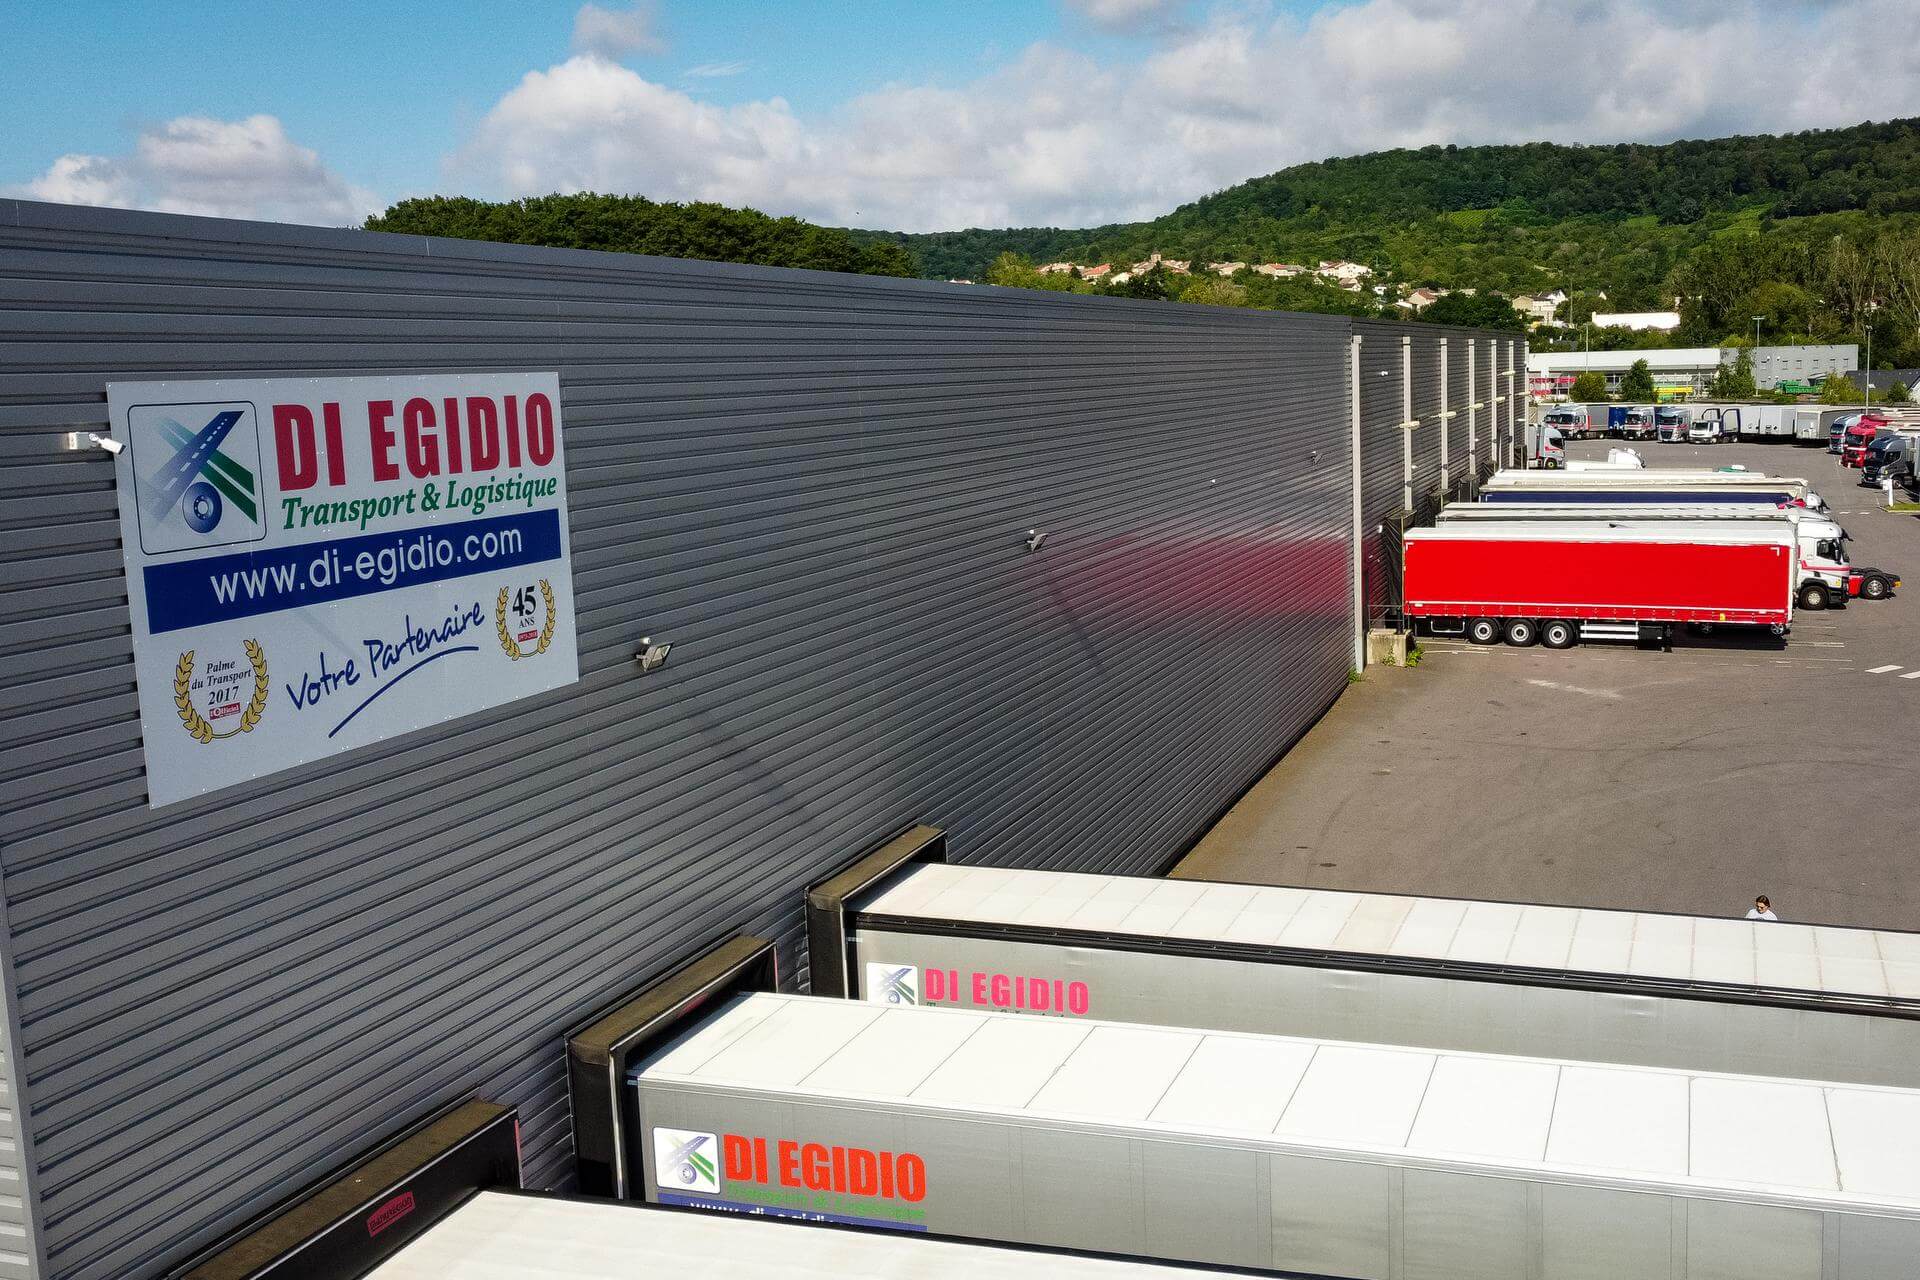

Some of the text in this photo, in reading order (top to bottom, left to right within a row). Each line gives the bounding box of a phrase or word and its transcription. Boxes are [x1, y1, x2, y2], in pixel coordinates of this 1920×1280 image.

[272, 392, 555, 492] DI EGIDIO
[281, 472, 558, 531] Transport & Logistique
[210, 528, 523, 605] www.di-egidio.com
[512, 585, 536, 617] 45
[519, 616, 535, 628] ANS
[191, 669, 252, 690] du Transport
[206, 660, 236, 674] Palme
[285, 601, 485, 711] Votre Partenaire
[208, 685, 240, 706] 2017
[925, 968, 959, 1002] DI
[971, 972, 1089, 1015] EGIDIO
[723, 1133, 927, 1203] DI EGIDIO
